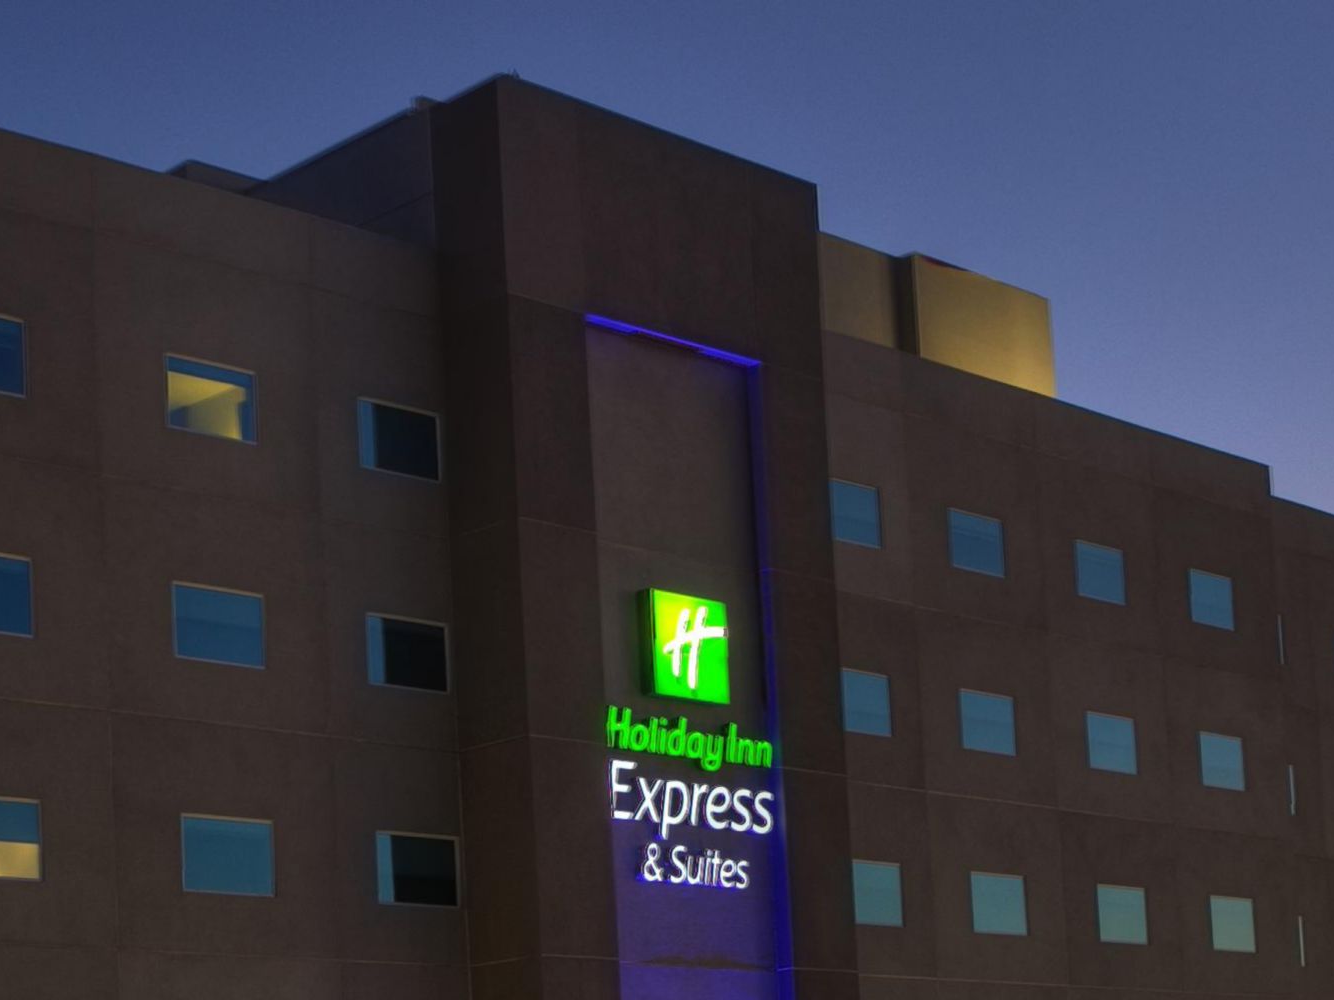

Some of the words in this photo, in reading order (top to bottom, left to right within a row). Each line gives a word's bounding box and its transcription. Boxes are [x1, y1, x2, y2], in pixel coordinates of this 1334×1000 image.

[607, 705, 724, 771] Holiday
[725, 722, 773, 768] Inn
[609, 759, 774, 839] Express
[643, 842, 663, 881] &
[667, 845, 750, 889] Suites
